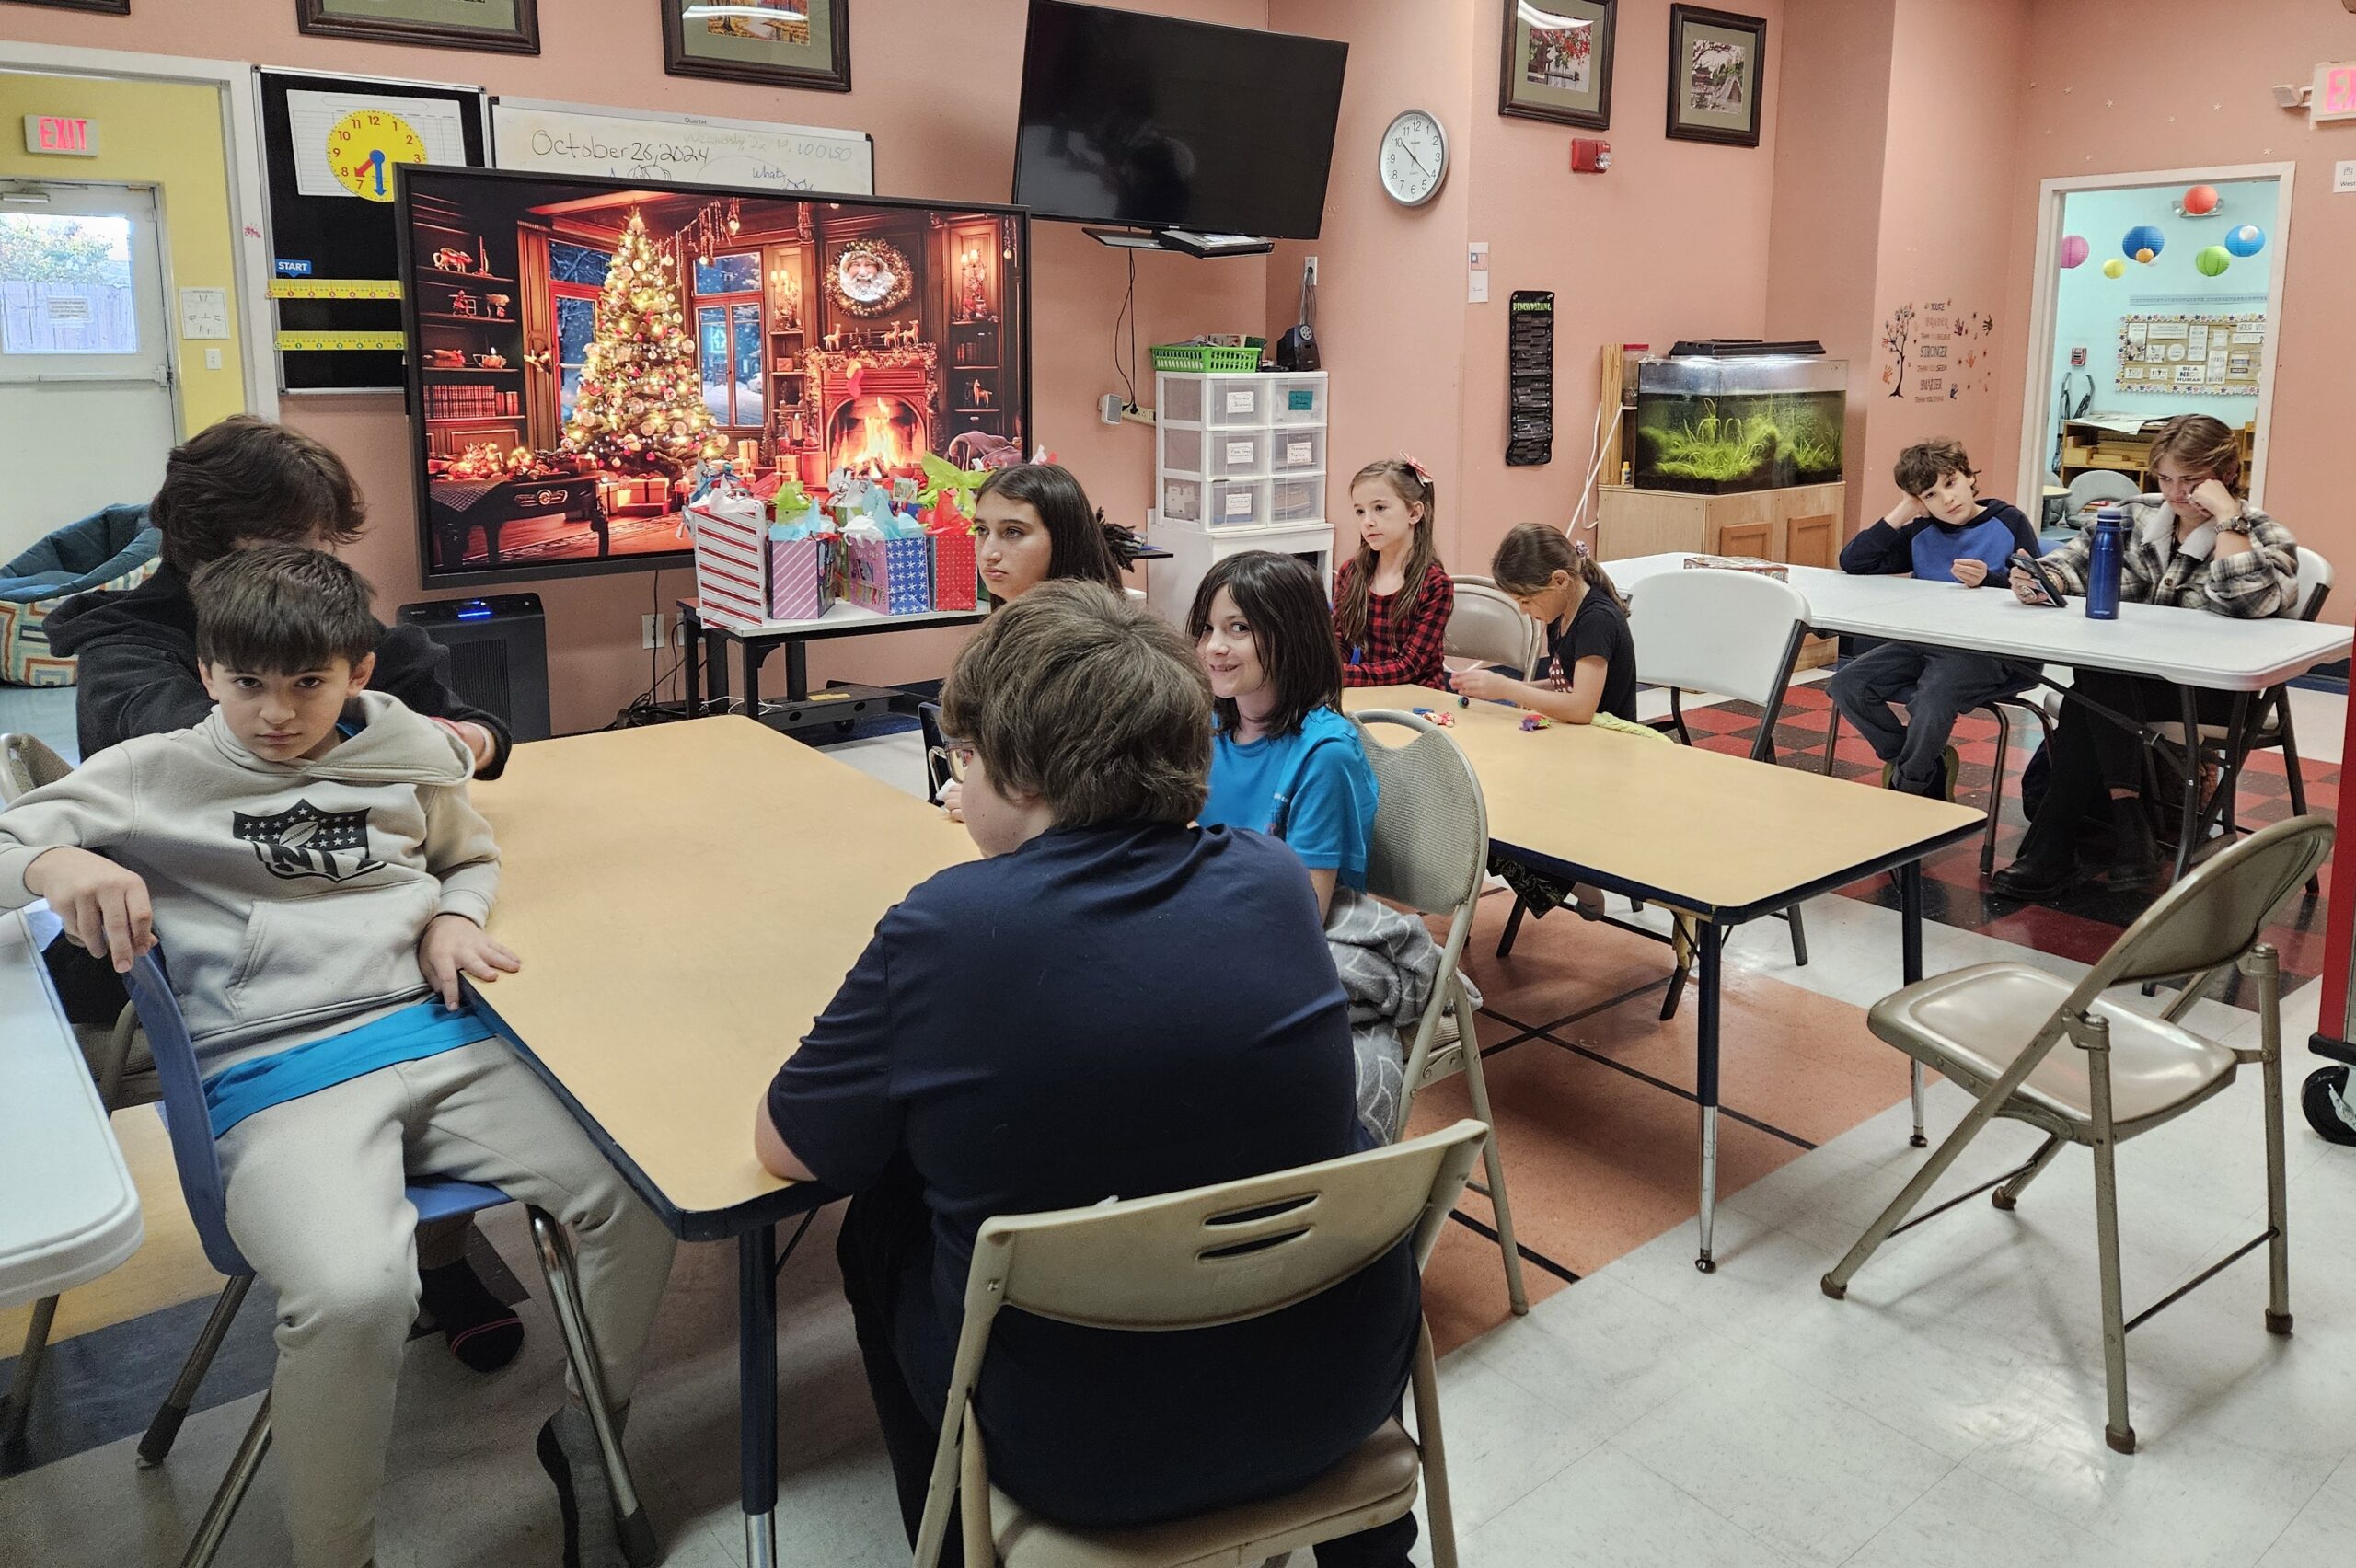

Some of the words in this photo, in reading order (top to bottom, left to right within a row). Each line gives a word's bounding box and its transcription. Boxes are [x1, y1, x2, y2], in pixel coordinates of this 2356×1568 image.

[352, 120, 361, 129] 11
[368, 116, 380, 126] 12
[393, 121, 398, 131] 1
[685, 117, 708, 125] Quartet
[39, 117, 87, 150] EXIT
[338, 131, 351, 141] 10
[406, 135, 413, 144] 2
[531, 129, 628, 158] October
[332, 148, 341, 157] 9
[341, 167, 349, 177] 8
[356, 179, 364, 190] 7
[278, 261, 308, 272] START
[1920, 346, 1947, 358] STRONGER
